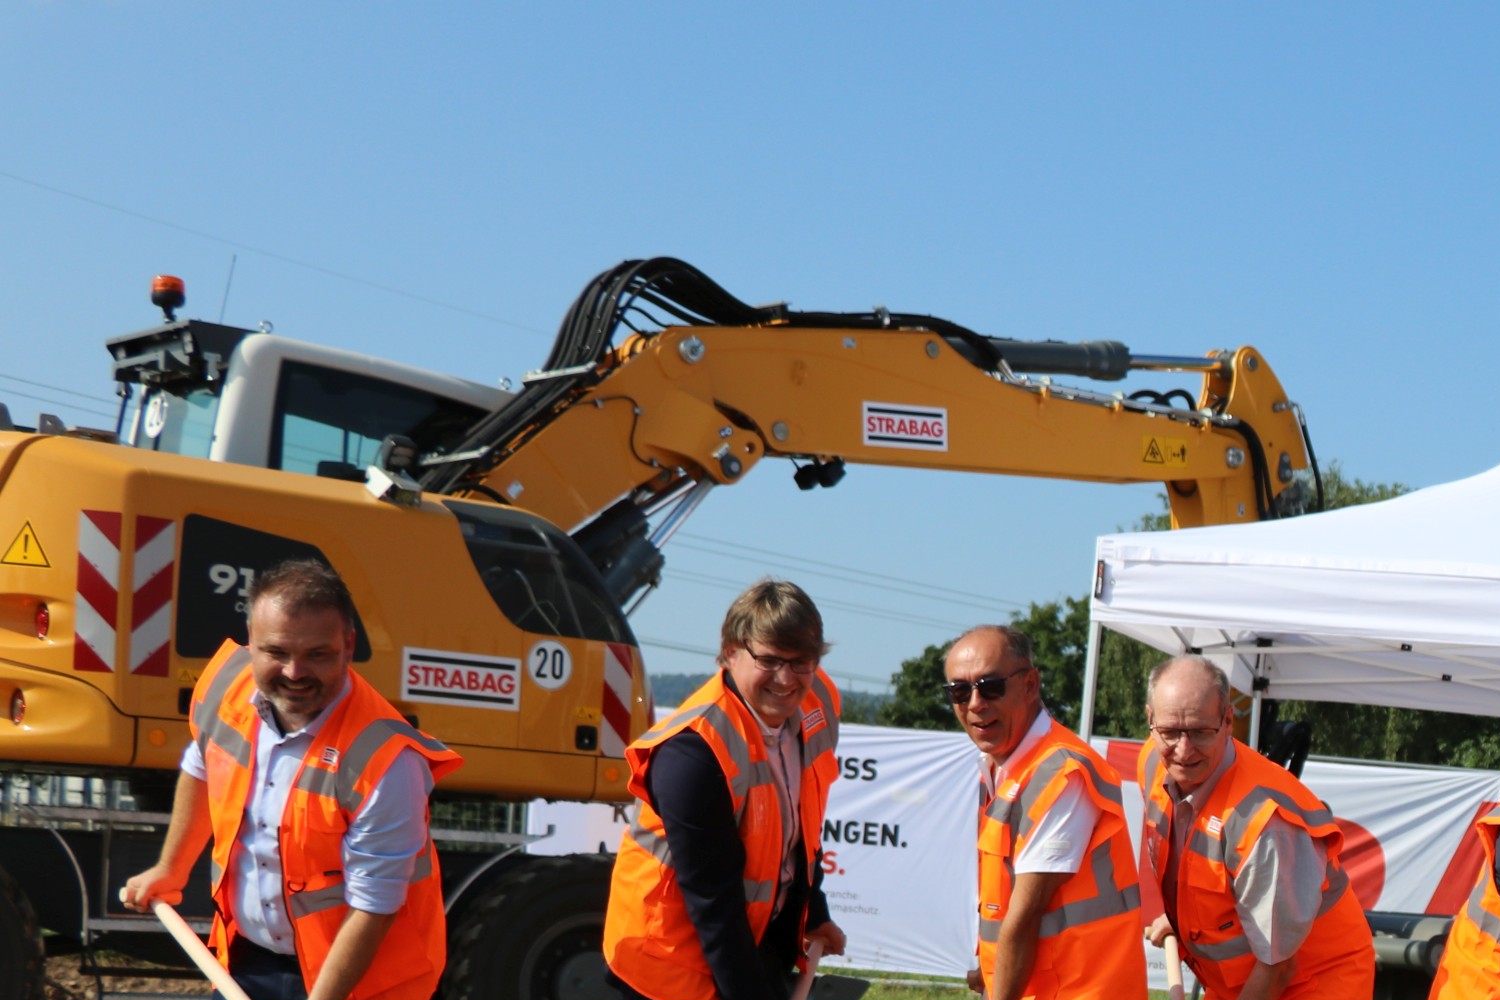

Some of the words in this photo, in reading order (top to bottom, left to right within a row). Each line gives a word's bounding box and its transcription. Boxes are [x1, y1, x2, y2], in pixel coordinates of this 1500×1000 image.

[867, 415, 944, 438] STRABAG
[208, 563, 255, 598] 91
[535, 647, 564, 680] 20
[408, 665, 516, 695] STRABAG
[838, 756, 878, 781] SS
[822, 819, 908, 848] NGEN.
